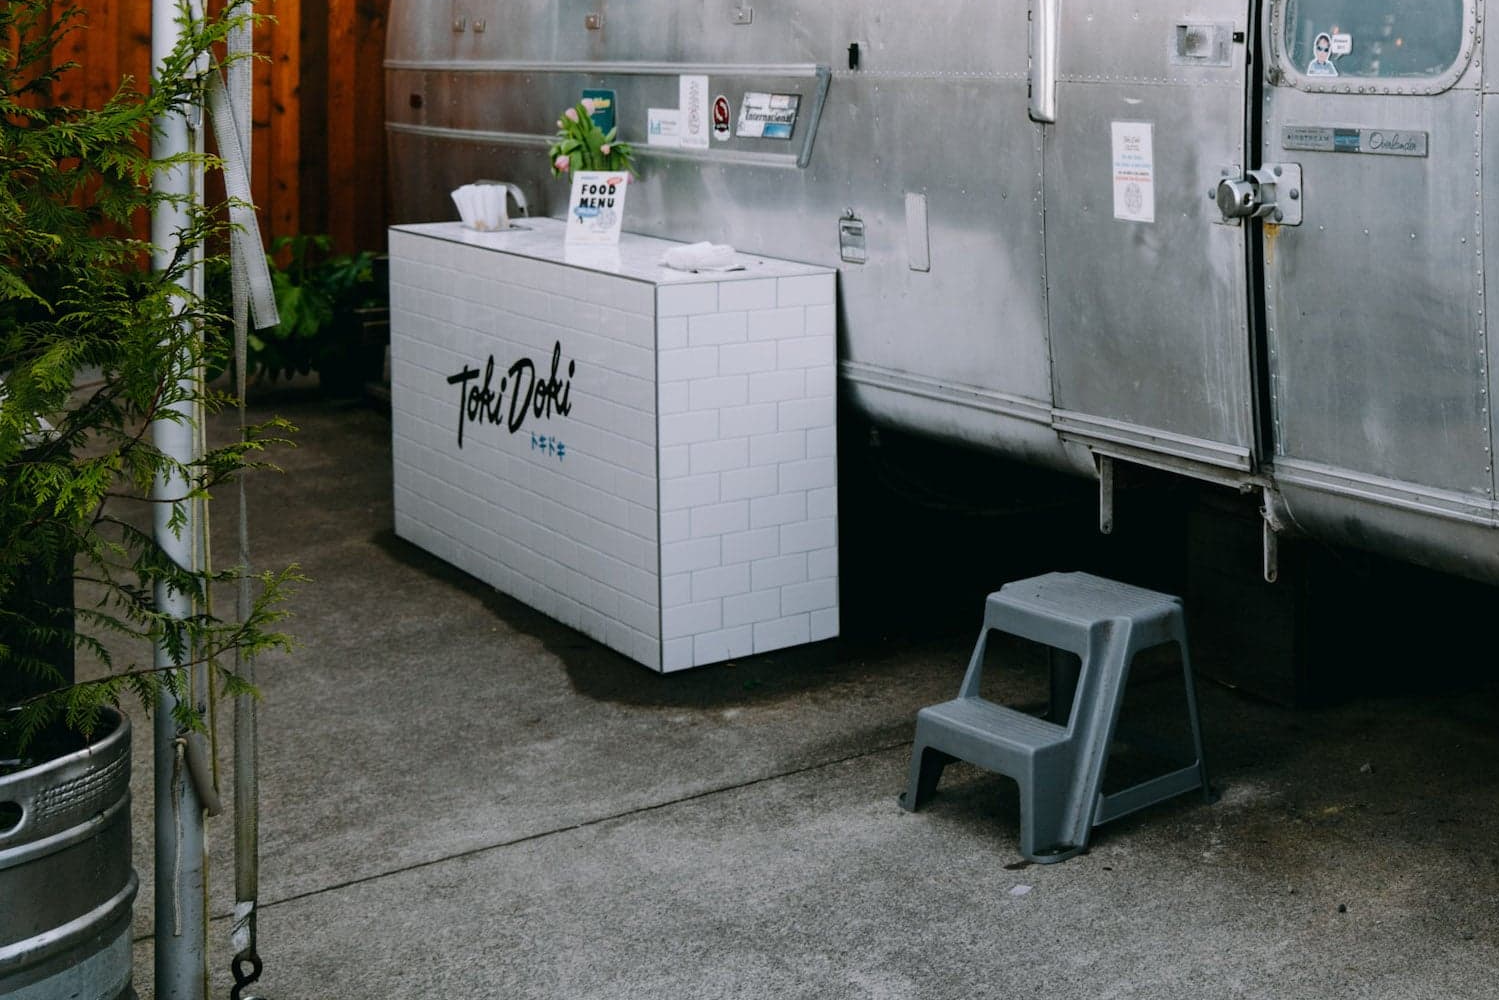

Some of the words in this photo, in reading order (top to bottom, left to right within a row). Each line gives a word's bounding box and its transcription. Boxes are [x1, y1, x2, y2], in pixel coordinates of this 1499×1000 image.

[581, 184, 617, 196] FOOD
[579, 197, 615, 208] MENU
[447, 354, 508, 449] Toki
[508, 340, 576, 434] Doki
